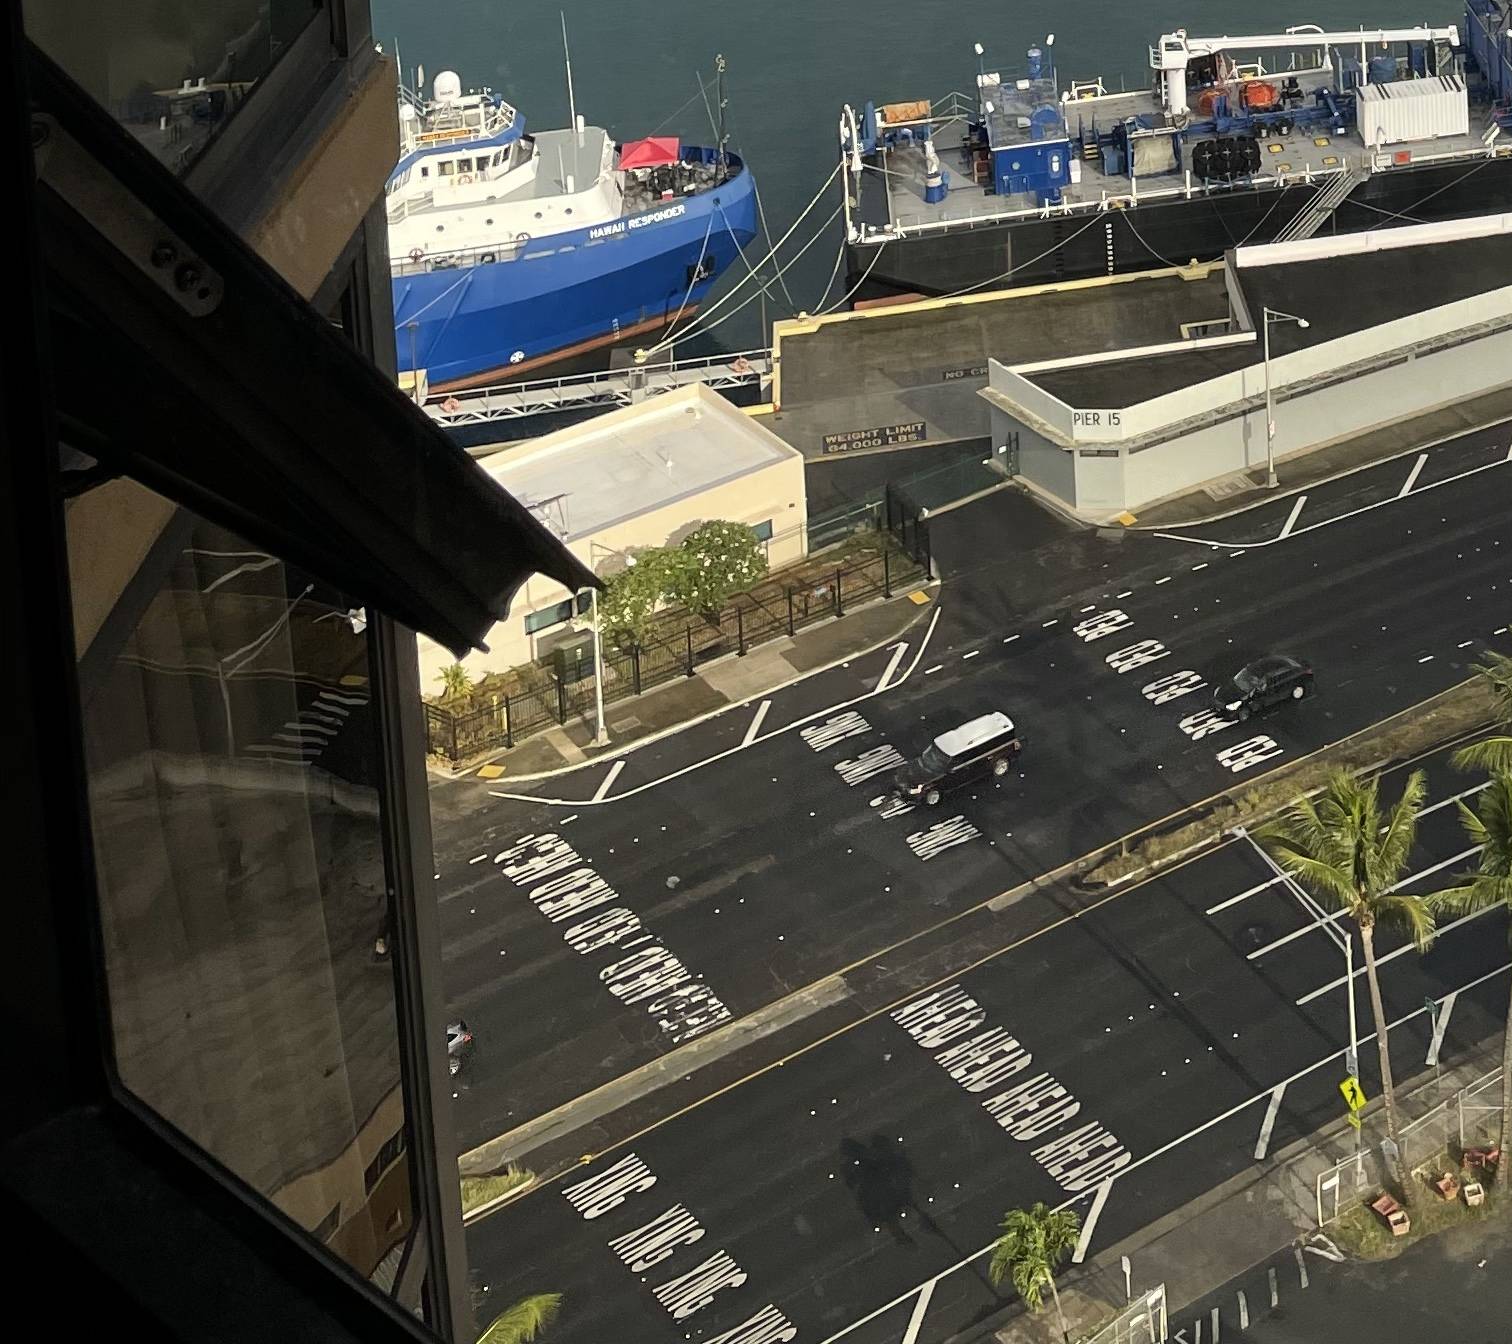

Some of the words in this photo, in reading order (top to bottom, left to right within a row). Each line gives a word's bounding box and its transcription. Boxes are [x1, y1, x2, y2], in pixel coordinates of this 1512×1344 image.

[589, 222, 625, 239] HAWAII
[628, 204, 686, 230] RESPONDER
[825, 429, 880, 444] WEIGHT
[886, 423, 924, 436] LIMIT
[1073, 412, 1101, 426] PIER
[1108, 412, 1121, 426] 15
[889, 983, 987, 1049] AHEAD
[933, 1025, 1033, 1093] AHEAD
[981, 1071, 1081, 1142] AHEAD
[561, 1152, 658, 1220] XING
[1030, 1120, 1132, 1192] AHEAD
[607, 1202, 706, 1273] XING
[652, 1249, 747, 1319] XING
